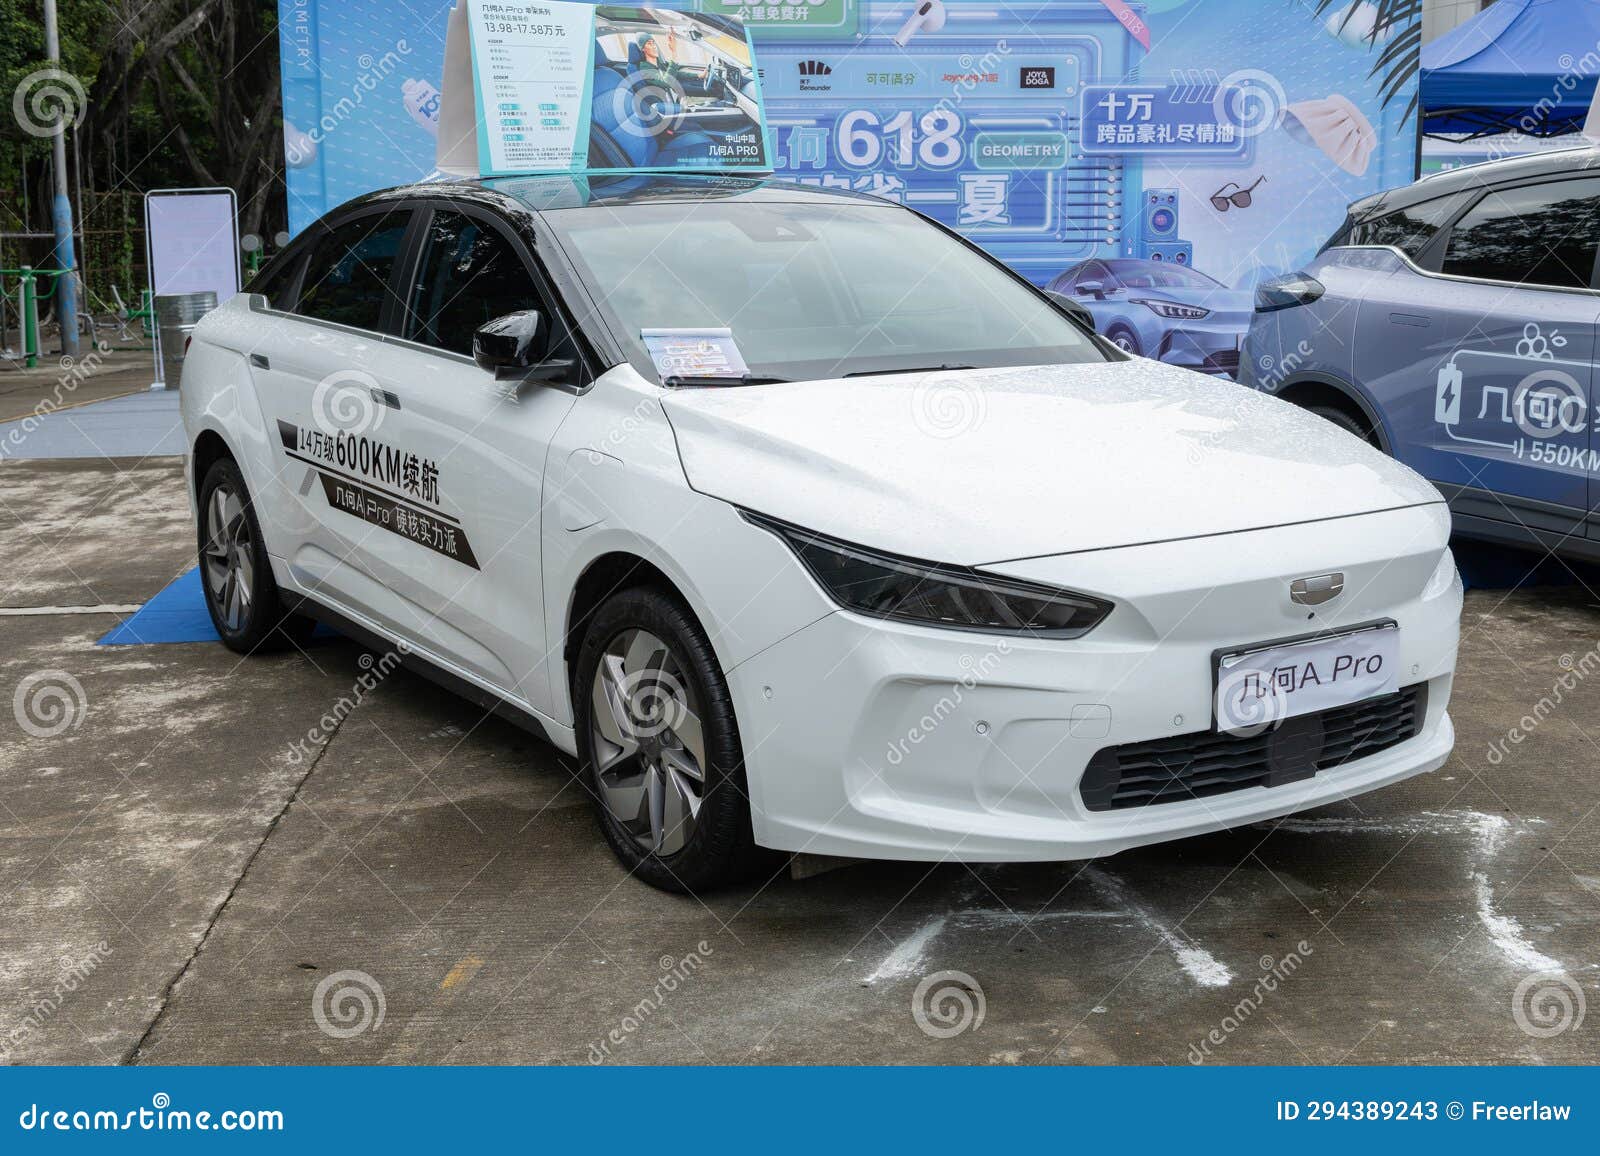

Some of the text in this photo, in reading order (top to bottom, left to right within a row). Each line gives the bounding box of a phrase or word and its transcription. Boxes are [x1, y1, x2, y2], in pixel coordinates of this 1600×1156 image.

[737, 6, 809, 21] 公里免费开
[1025, 71, 1048, 79] JOY&
[1025, 78, 1050, 86] DOGA
[1098, 92, 1155, 121] 十万
[837, 110, 962, 167] 618
[1097, 124, 1235, 144] 跨品豪礼尽情抽
[708, 145, 758, 156] 几何A PRO
[982, 144, 1062, 158] GEOMETRY
[336, 486, 458, 555] 几何A Pro 硬核实力派
[1240, 654, 1383, 704] 几何A Pro
